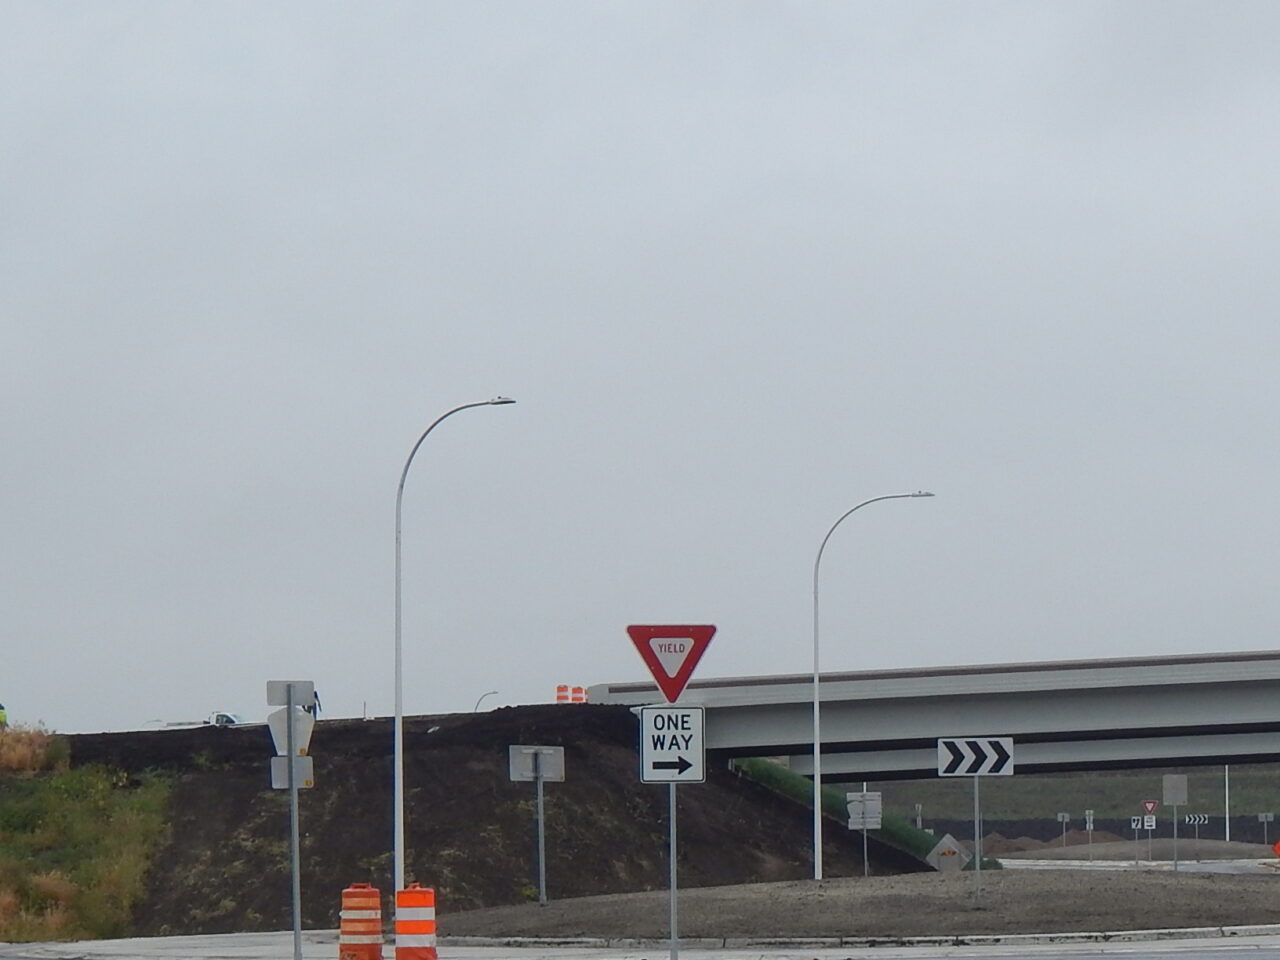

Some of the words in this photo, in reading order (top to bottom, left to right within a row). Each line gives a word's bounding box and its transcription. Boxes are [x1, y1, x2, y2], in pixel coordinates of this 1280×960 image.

[658, 643, 685, 654] YIELD
[653, 713, 691, 731] ONE
[651, 733, 693, 751] WAY
